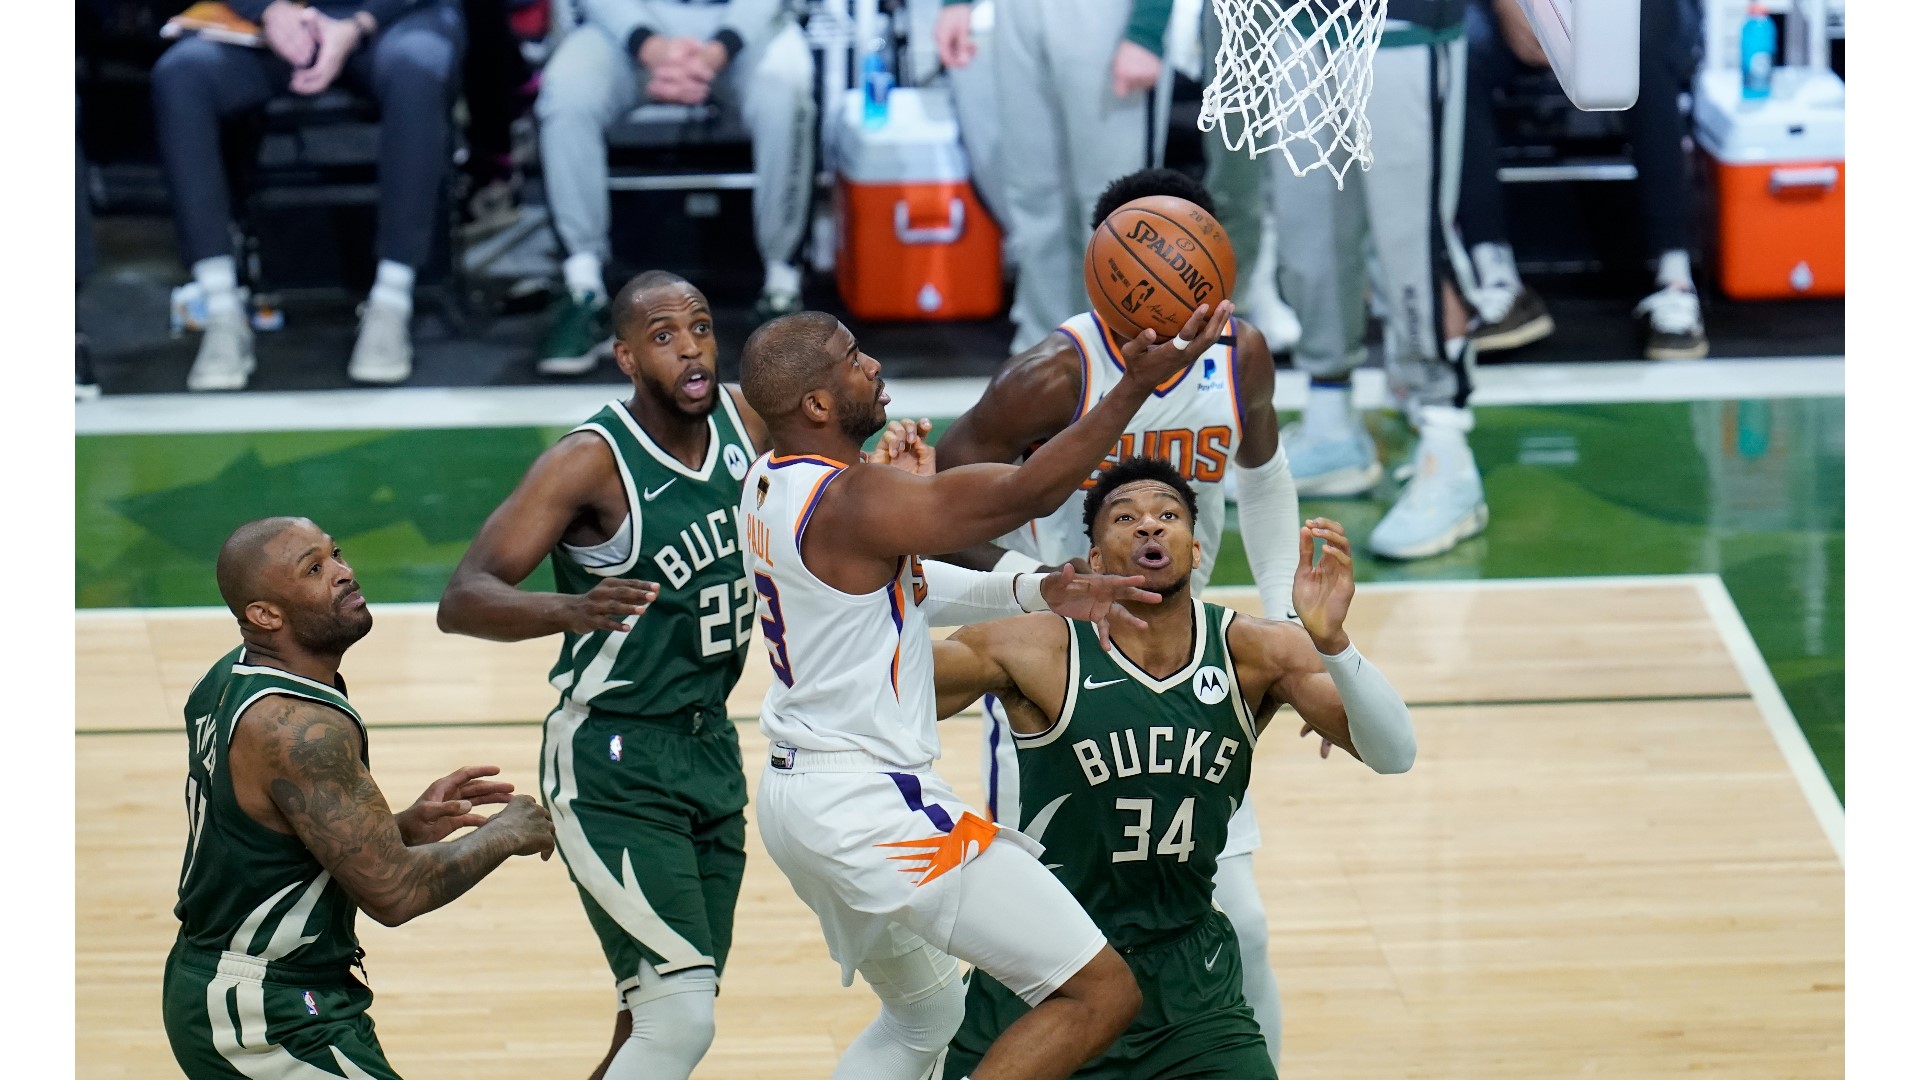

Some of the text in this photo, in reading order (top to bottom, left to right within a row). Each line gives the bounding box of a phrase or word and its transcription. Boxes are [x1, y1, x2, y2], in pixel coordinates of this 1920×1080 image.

[1126, 220, 1213, 303] SPALDING
[747, 513, 774, 567] PAUL
[700, 576, 755, 657] 22
[754, 568, 795, 689] 3
[1072, 726, 1240, 786] BUCKS
[1112, 797, 1196, 864] 34
